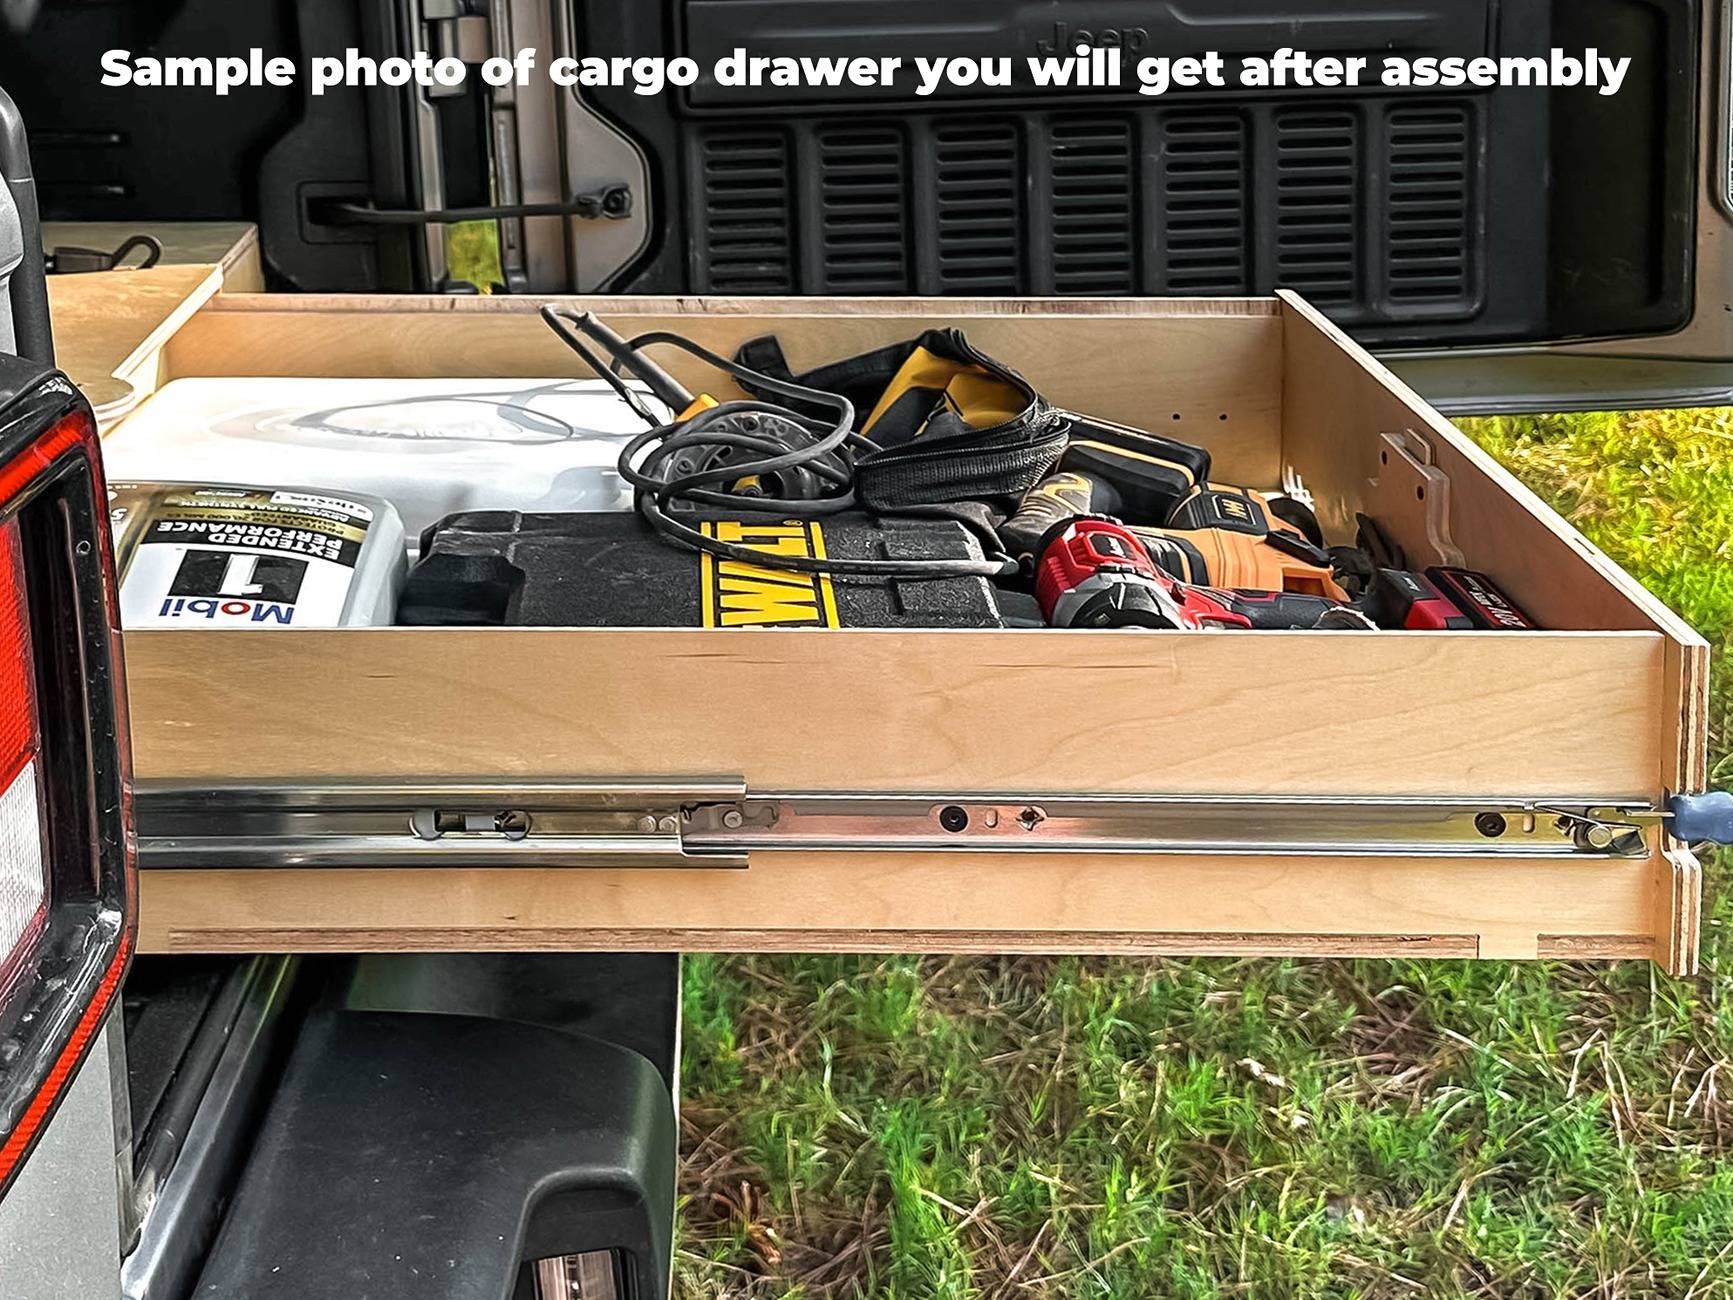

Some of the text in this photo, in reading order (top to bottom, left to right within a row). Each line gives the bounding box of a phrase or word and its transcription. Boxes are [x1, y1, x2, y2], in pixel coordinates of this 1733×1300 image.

[1036, 21, 1149, 67] Jeep
[157, 521, 343, 547] PERFORMANCE
[208, 533, 340, 561] EXTENDED
[217, 553, 263, 596] 1
[158, 598, 295, 625] Mobil
